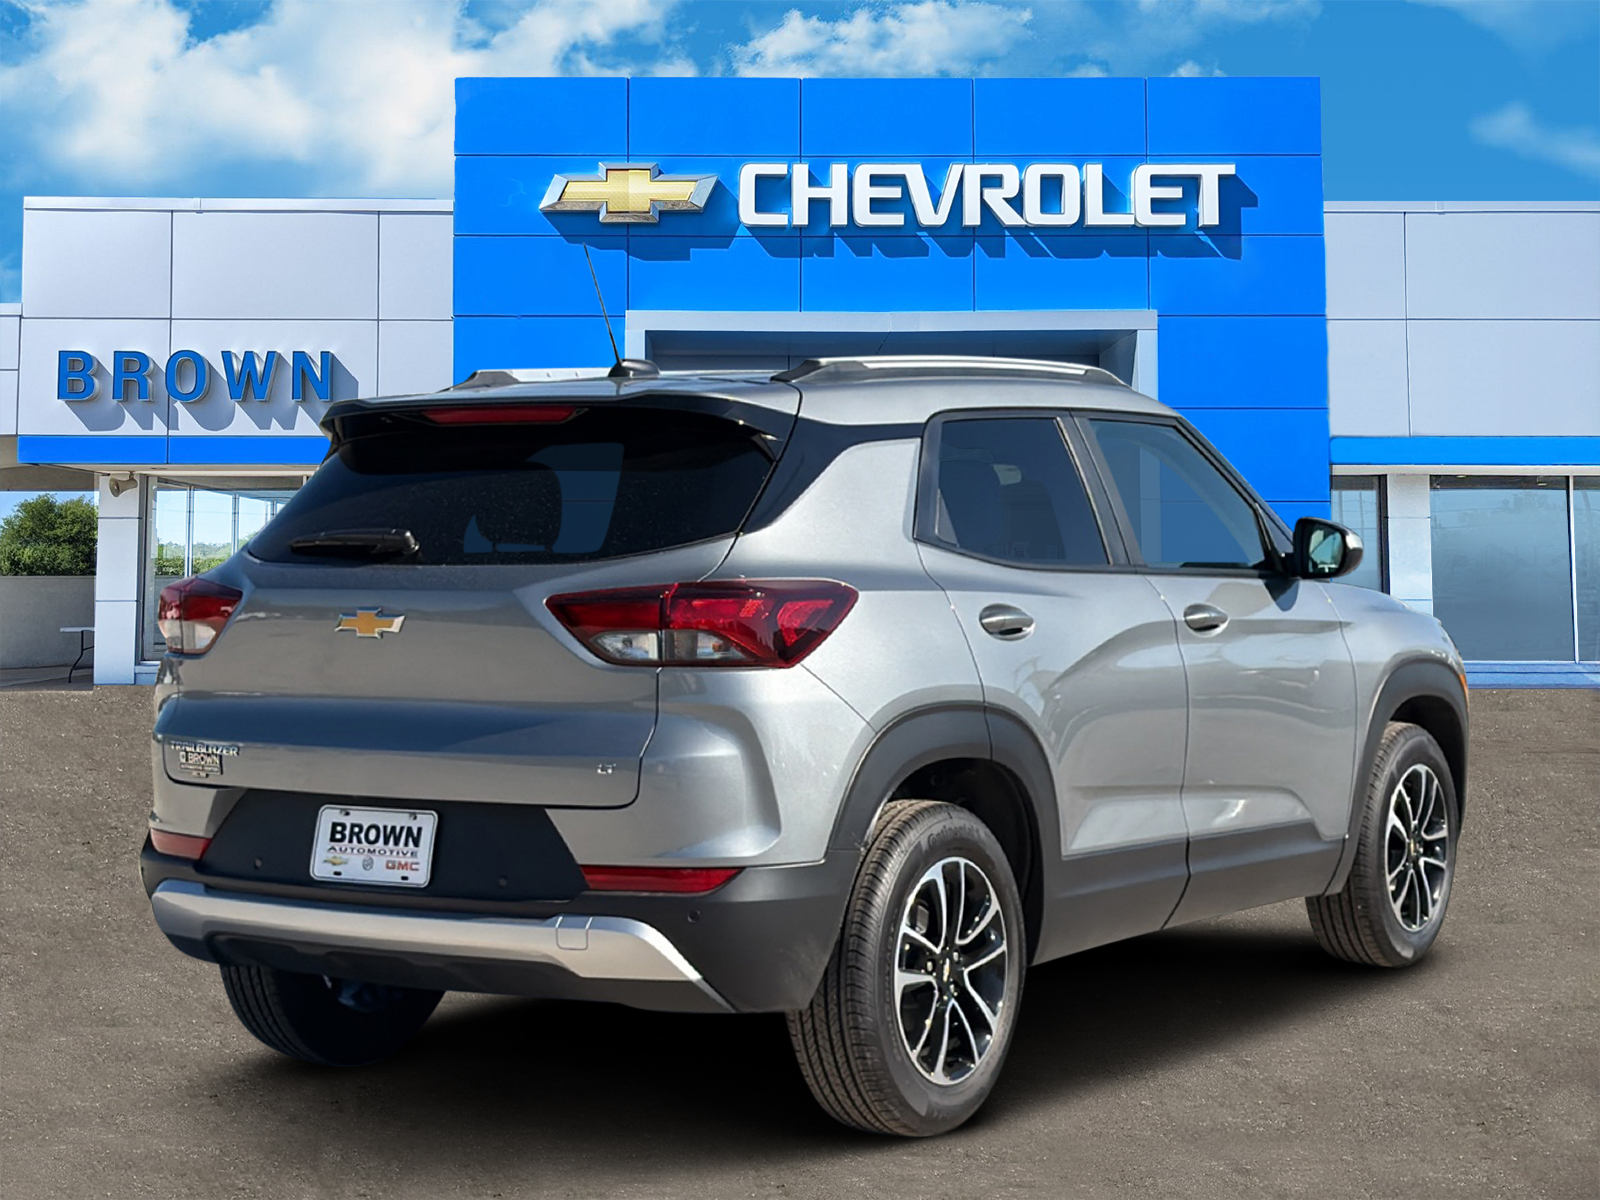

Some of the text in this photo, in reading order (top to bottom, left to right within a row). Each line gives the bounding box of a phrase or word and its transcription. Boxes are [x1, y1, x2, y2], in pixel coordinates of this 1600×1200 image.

[738, 162, 1236, 228] CHEVROLET
[57, 349, 334, 402] BROWN
[170, 741, 238, 757] TRAILBLAZER
[188, 752, 219, 765] BROWN
[329, 821, 422, 848] BROWN
[327, 845, 418, 858] AUTOMOTIVE
[385, 859, 420, 872] GMC
